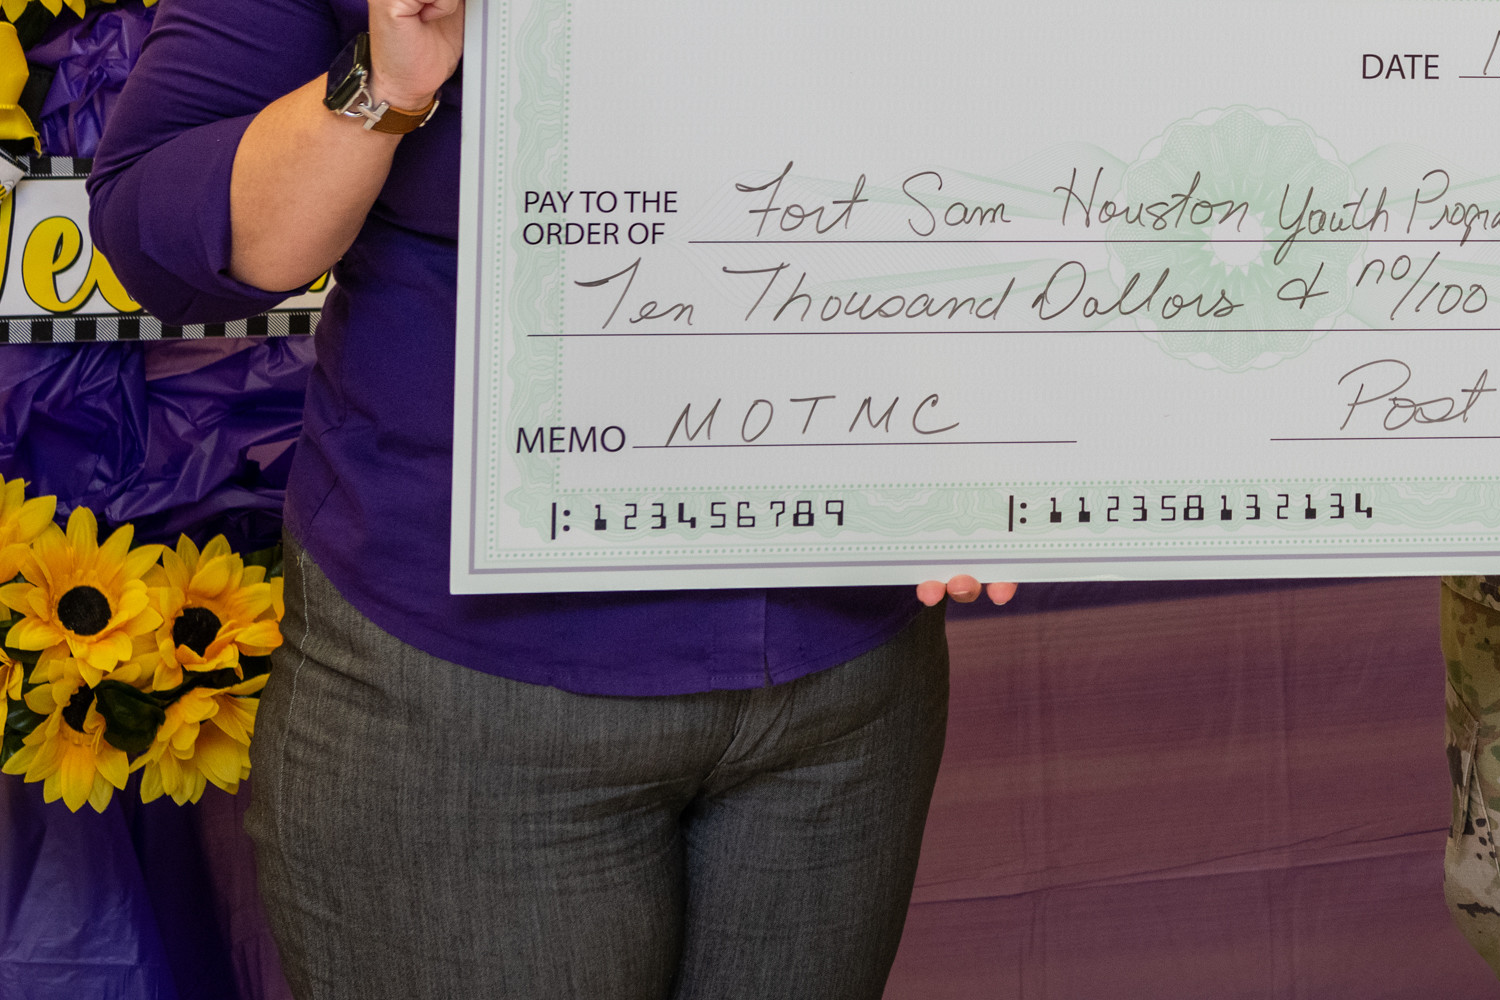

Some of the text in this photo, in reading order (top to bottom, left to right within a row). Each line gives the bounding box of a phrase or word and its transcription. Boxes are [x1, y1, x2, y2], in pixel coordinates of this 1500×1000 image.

[1362, 53, 1440, 80] DATE
[524, 190, 678, 214] PAY TO THE
[735, 161, 868, 237] Fort
[902, 171, 1011, 236] Sam
[1053, 167, 1251, 232] Houston
[1274, 183, 1389, 265] Youth
[522, 222, 665, 245] ORDER OF
[574, 257, 694, 329] Ten
[722, 262, 1016, 321] Thousand
[1339, 359, 1497, 430] Post
[515, 426, 626, 454] MEMO
